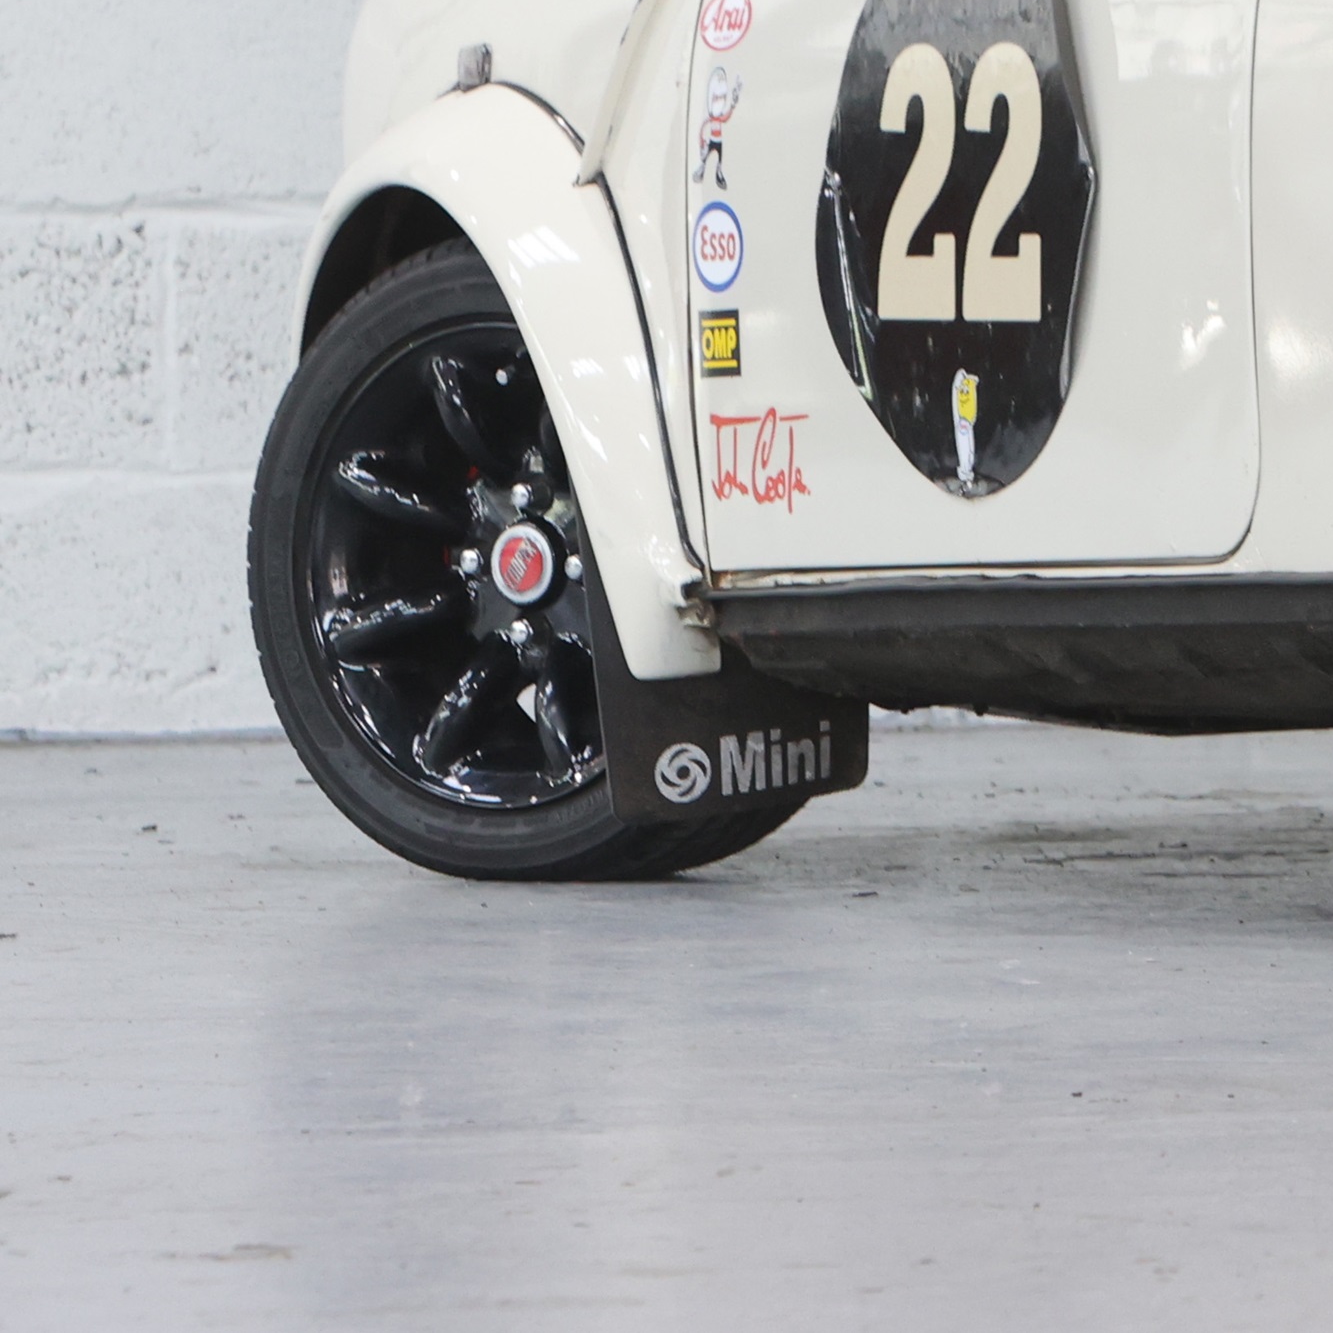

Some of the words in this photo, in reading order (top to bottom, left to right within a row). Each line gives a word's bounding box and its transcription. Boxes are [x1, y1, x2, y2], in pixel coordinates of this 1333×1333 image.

[877, 42, 1042, 322] 22
[702, 327, 738, 359] OMP
[718, 719, 832, 797] Mini
